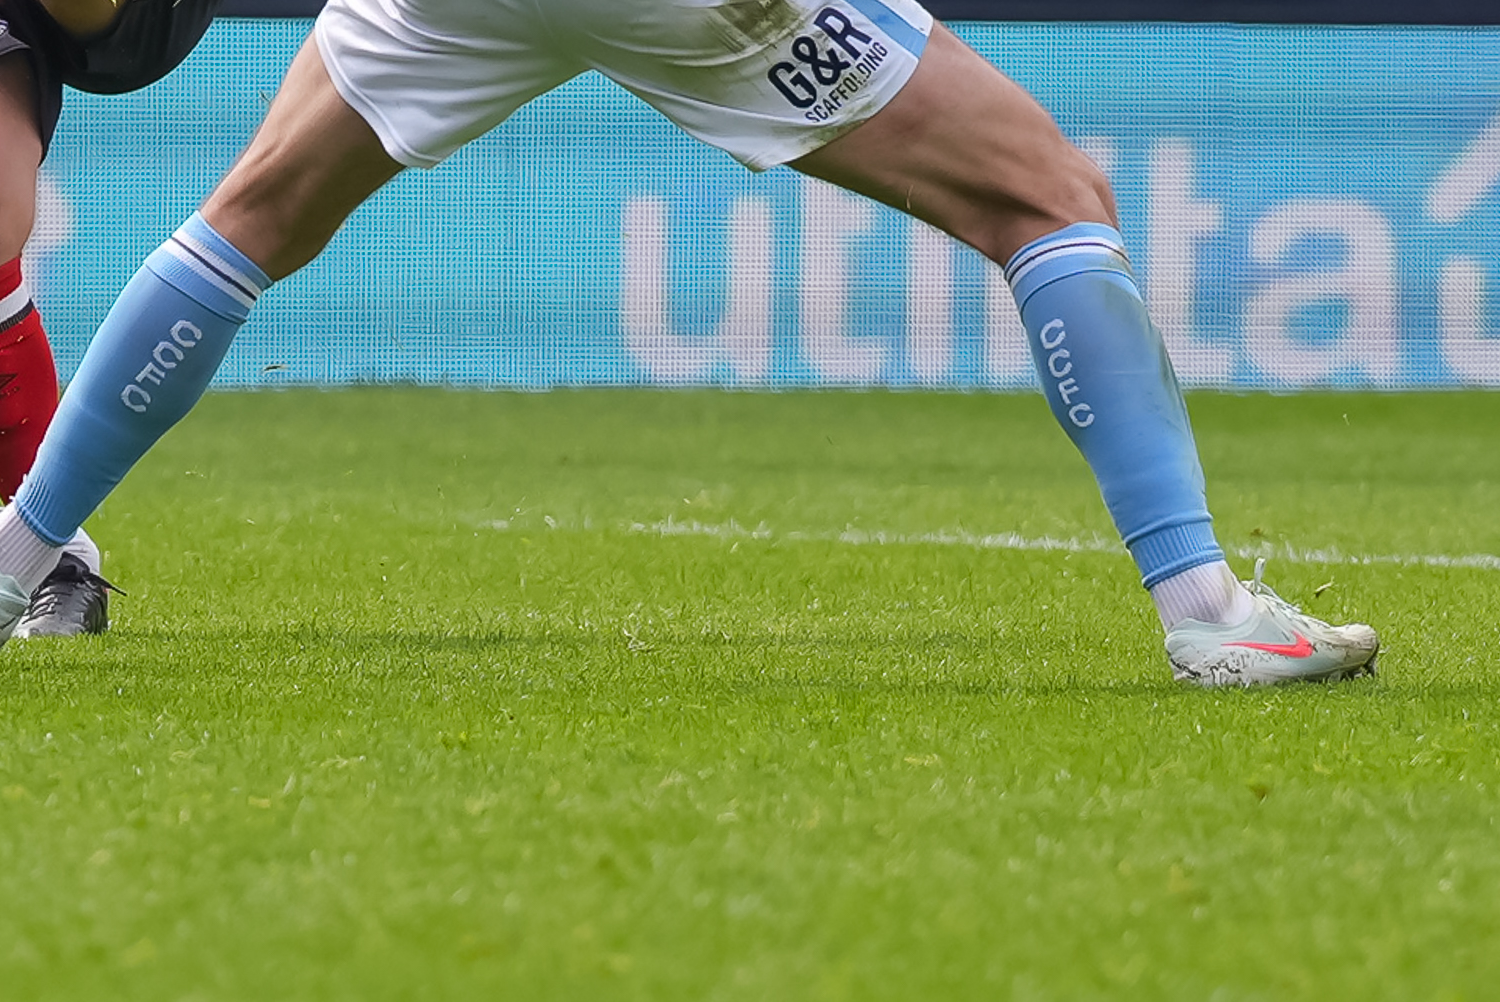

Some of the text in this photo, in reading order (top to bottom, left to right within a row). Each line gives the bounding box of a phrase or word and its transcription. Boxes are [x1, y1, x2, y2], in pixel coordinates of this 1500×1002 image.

[767, 6, 873, 109] G&R
[804, 41, 888, 122] SCAFFOLDING
[120, 319, 203, 413] CCFC
[1040, 318, 1095, 428] CCFC
